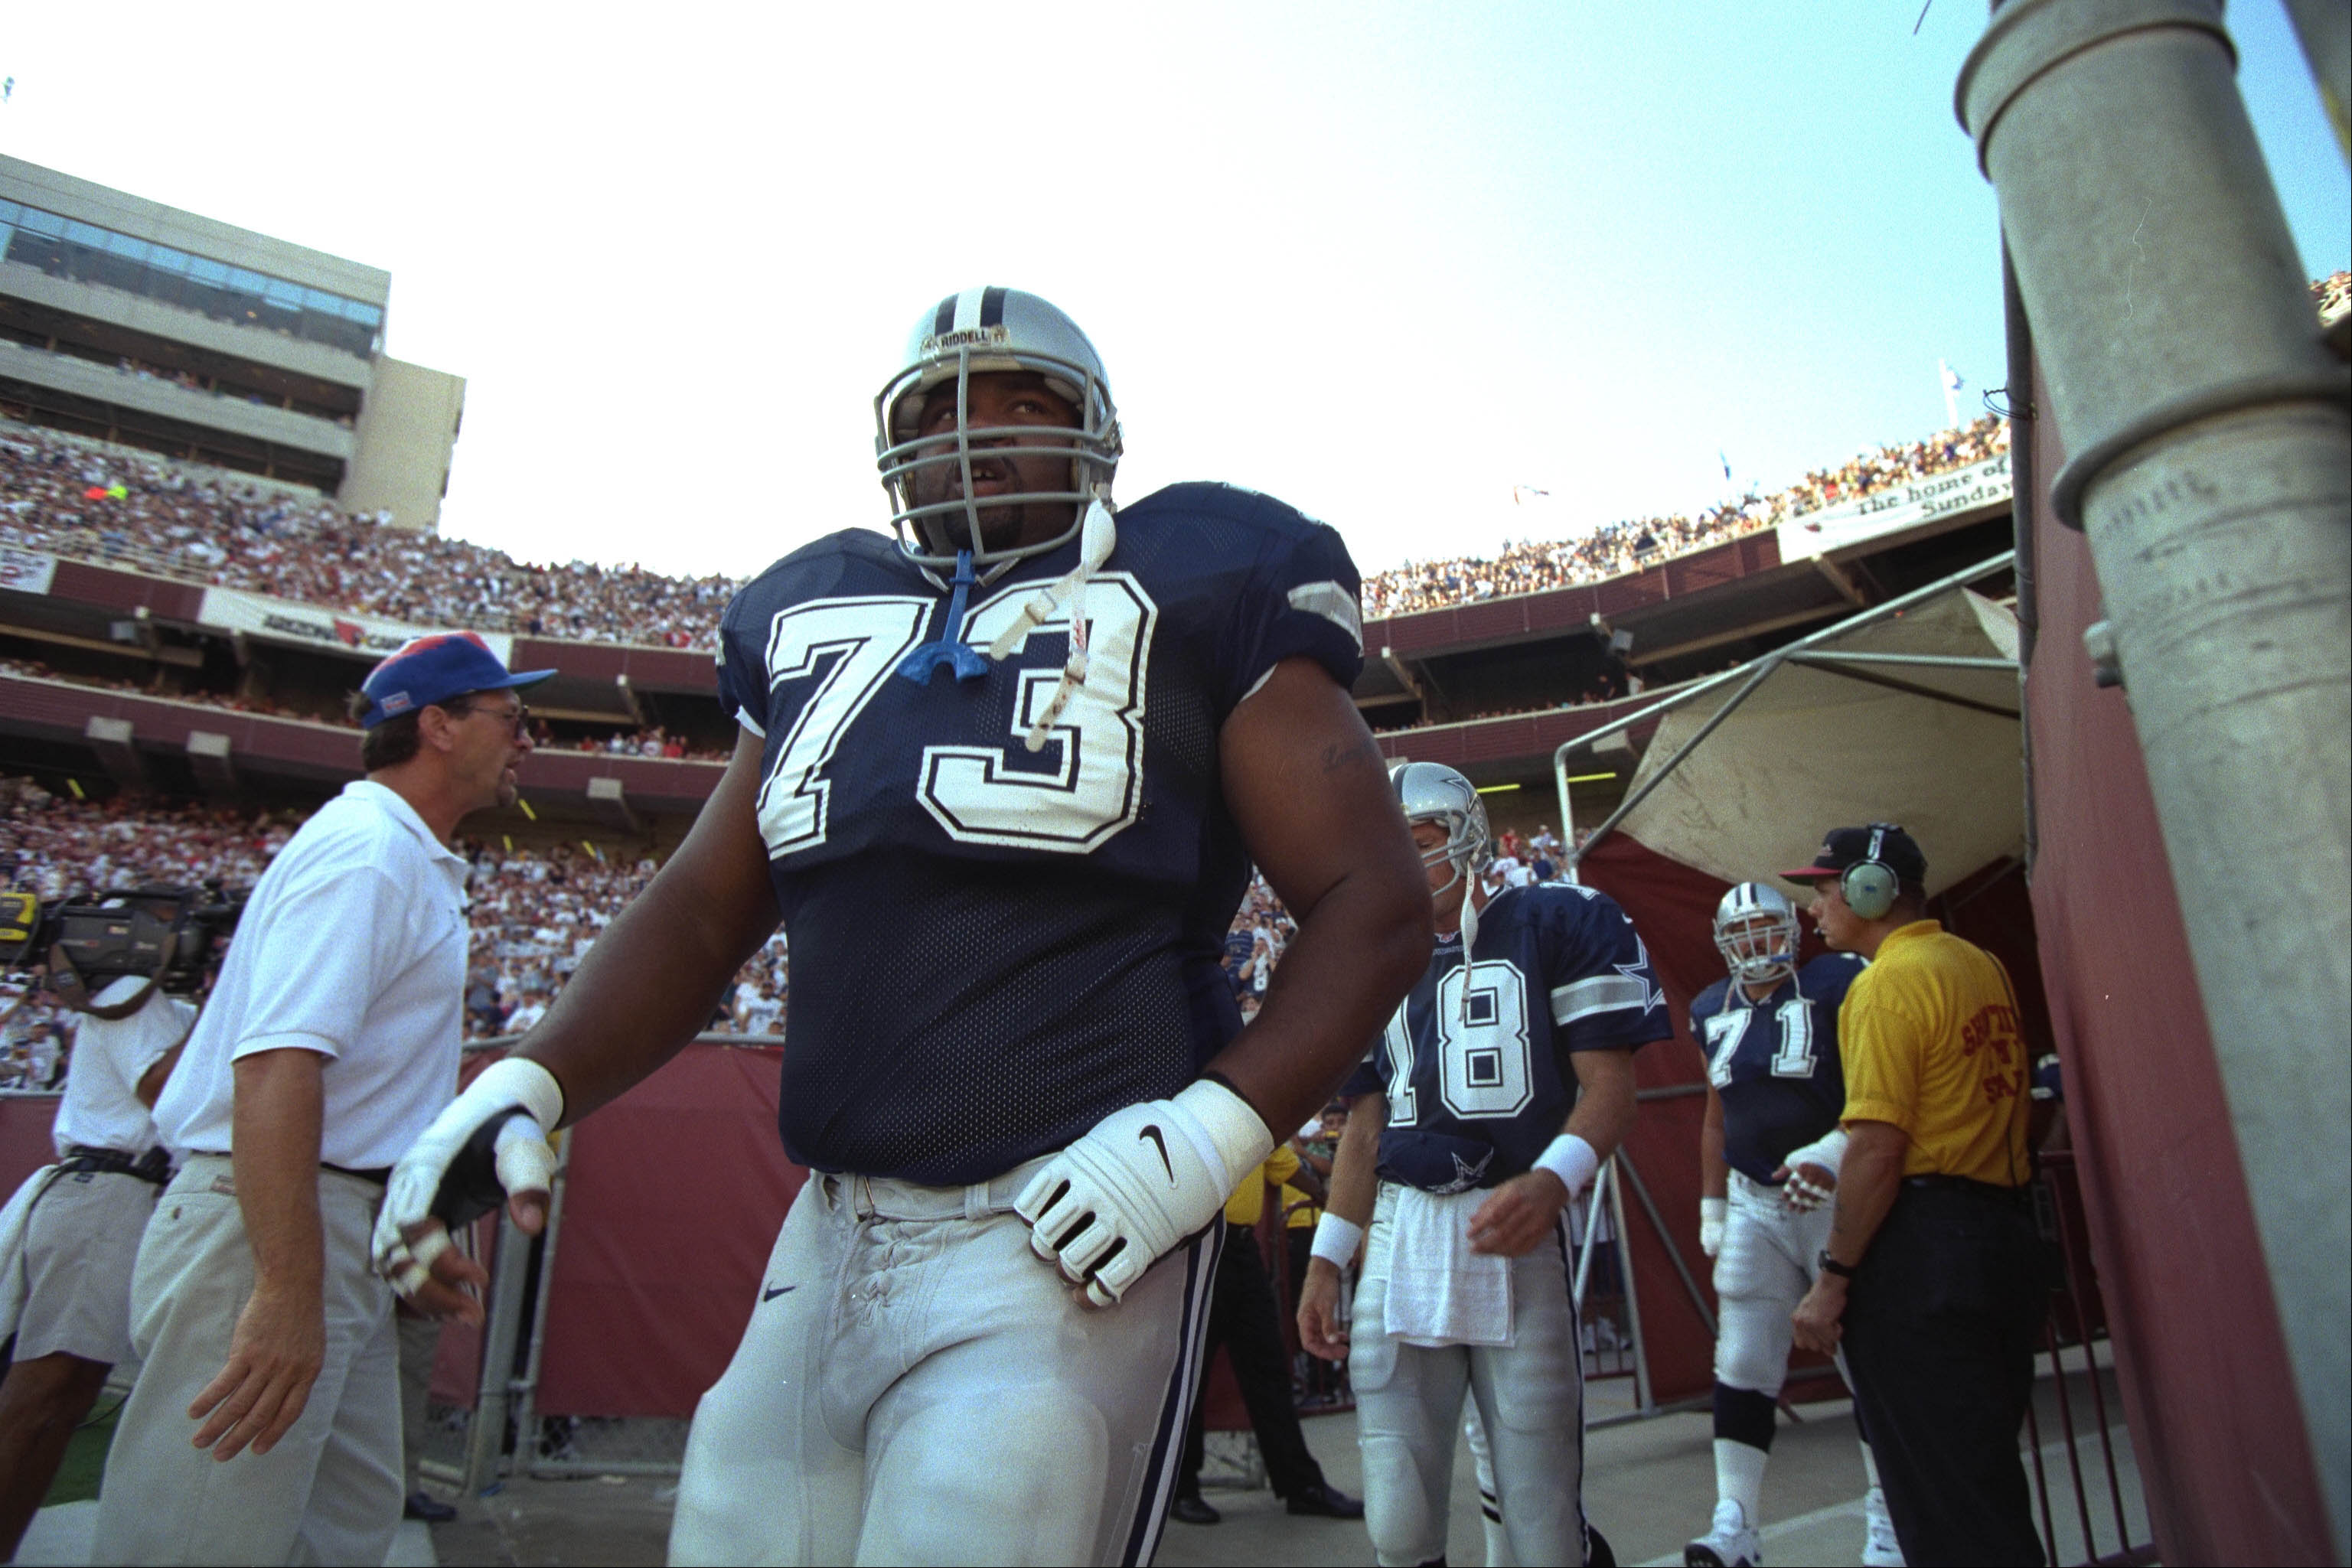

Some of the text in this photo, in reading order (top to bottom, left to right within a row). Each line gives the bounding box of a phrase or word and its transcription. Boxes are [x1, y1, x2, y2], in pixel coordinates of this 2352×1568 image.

[941, 328, 987, 347] RIDDELL
[1858, 491, 1900, 516] The
[1907, 473, 1972, 503] home
[758, 572, 1158, 861] 73
[1384, 959, 1535, 1127] 18
[1704, 999, 1819, 1090] 71
